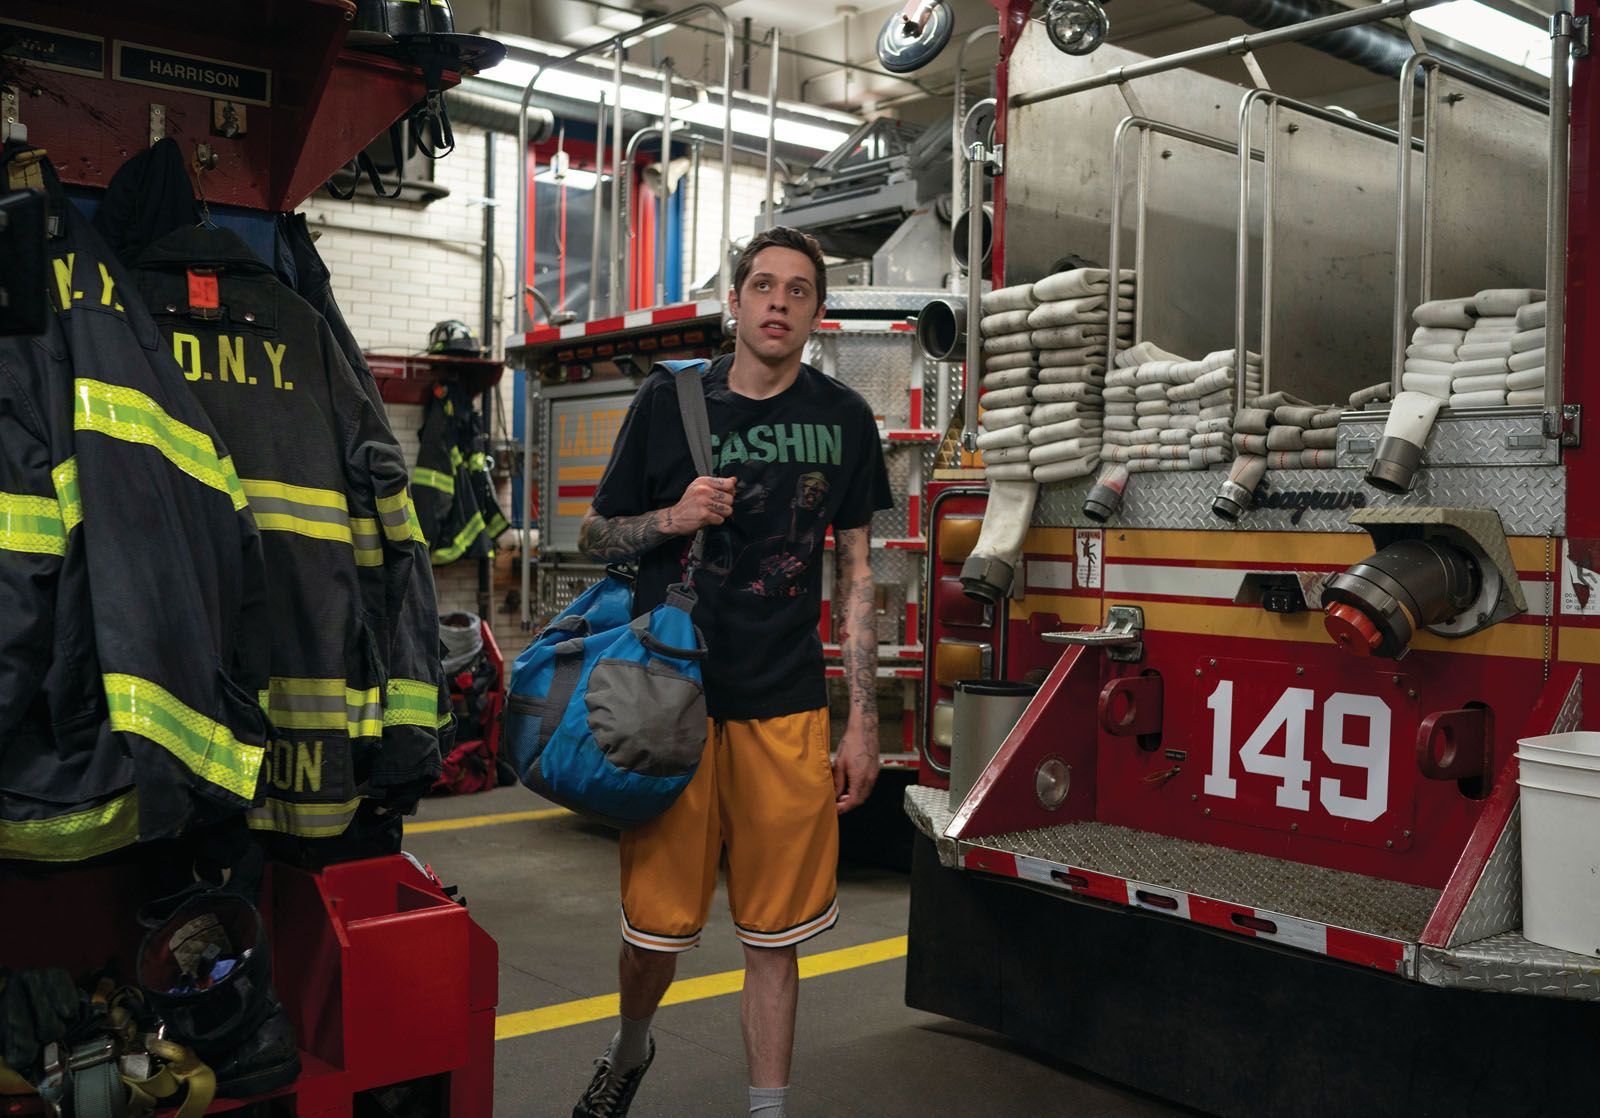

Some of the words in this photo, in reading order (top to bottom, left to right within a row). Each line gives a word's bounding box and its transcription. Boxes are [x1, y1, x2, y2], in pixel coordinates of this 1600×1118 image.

[149, 59, 240, 88] HARRISON
[559, 408, 629, 457] LADD
[1204, 679, 1392, 822] 149
